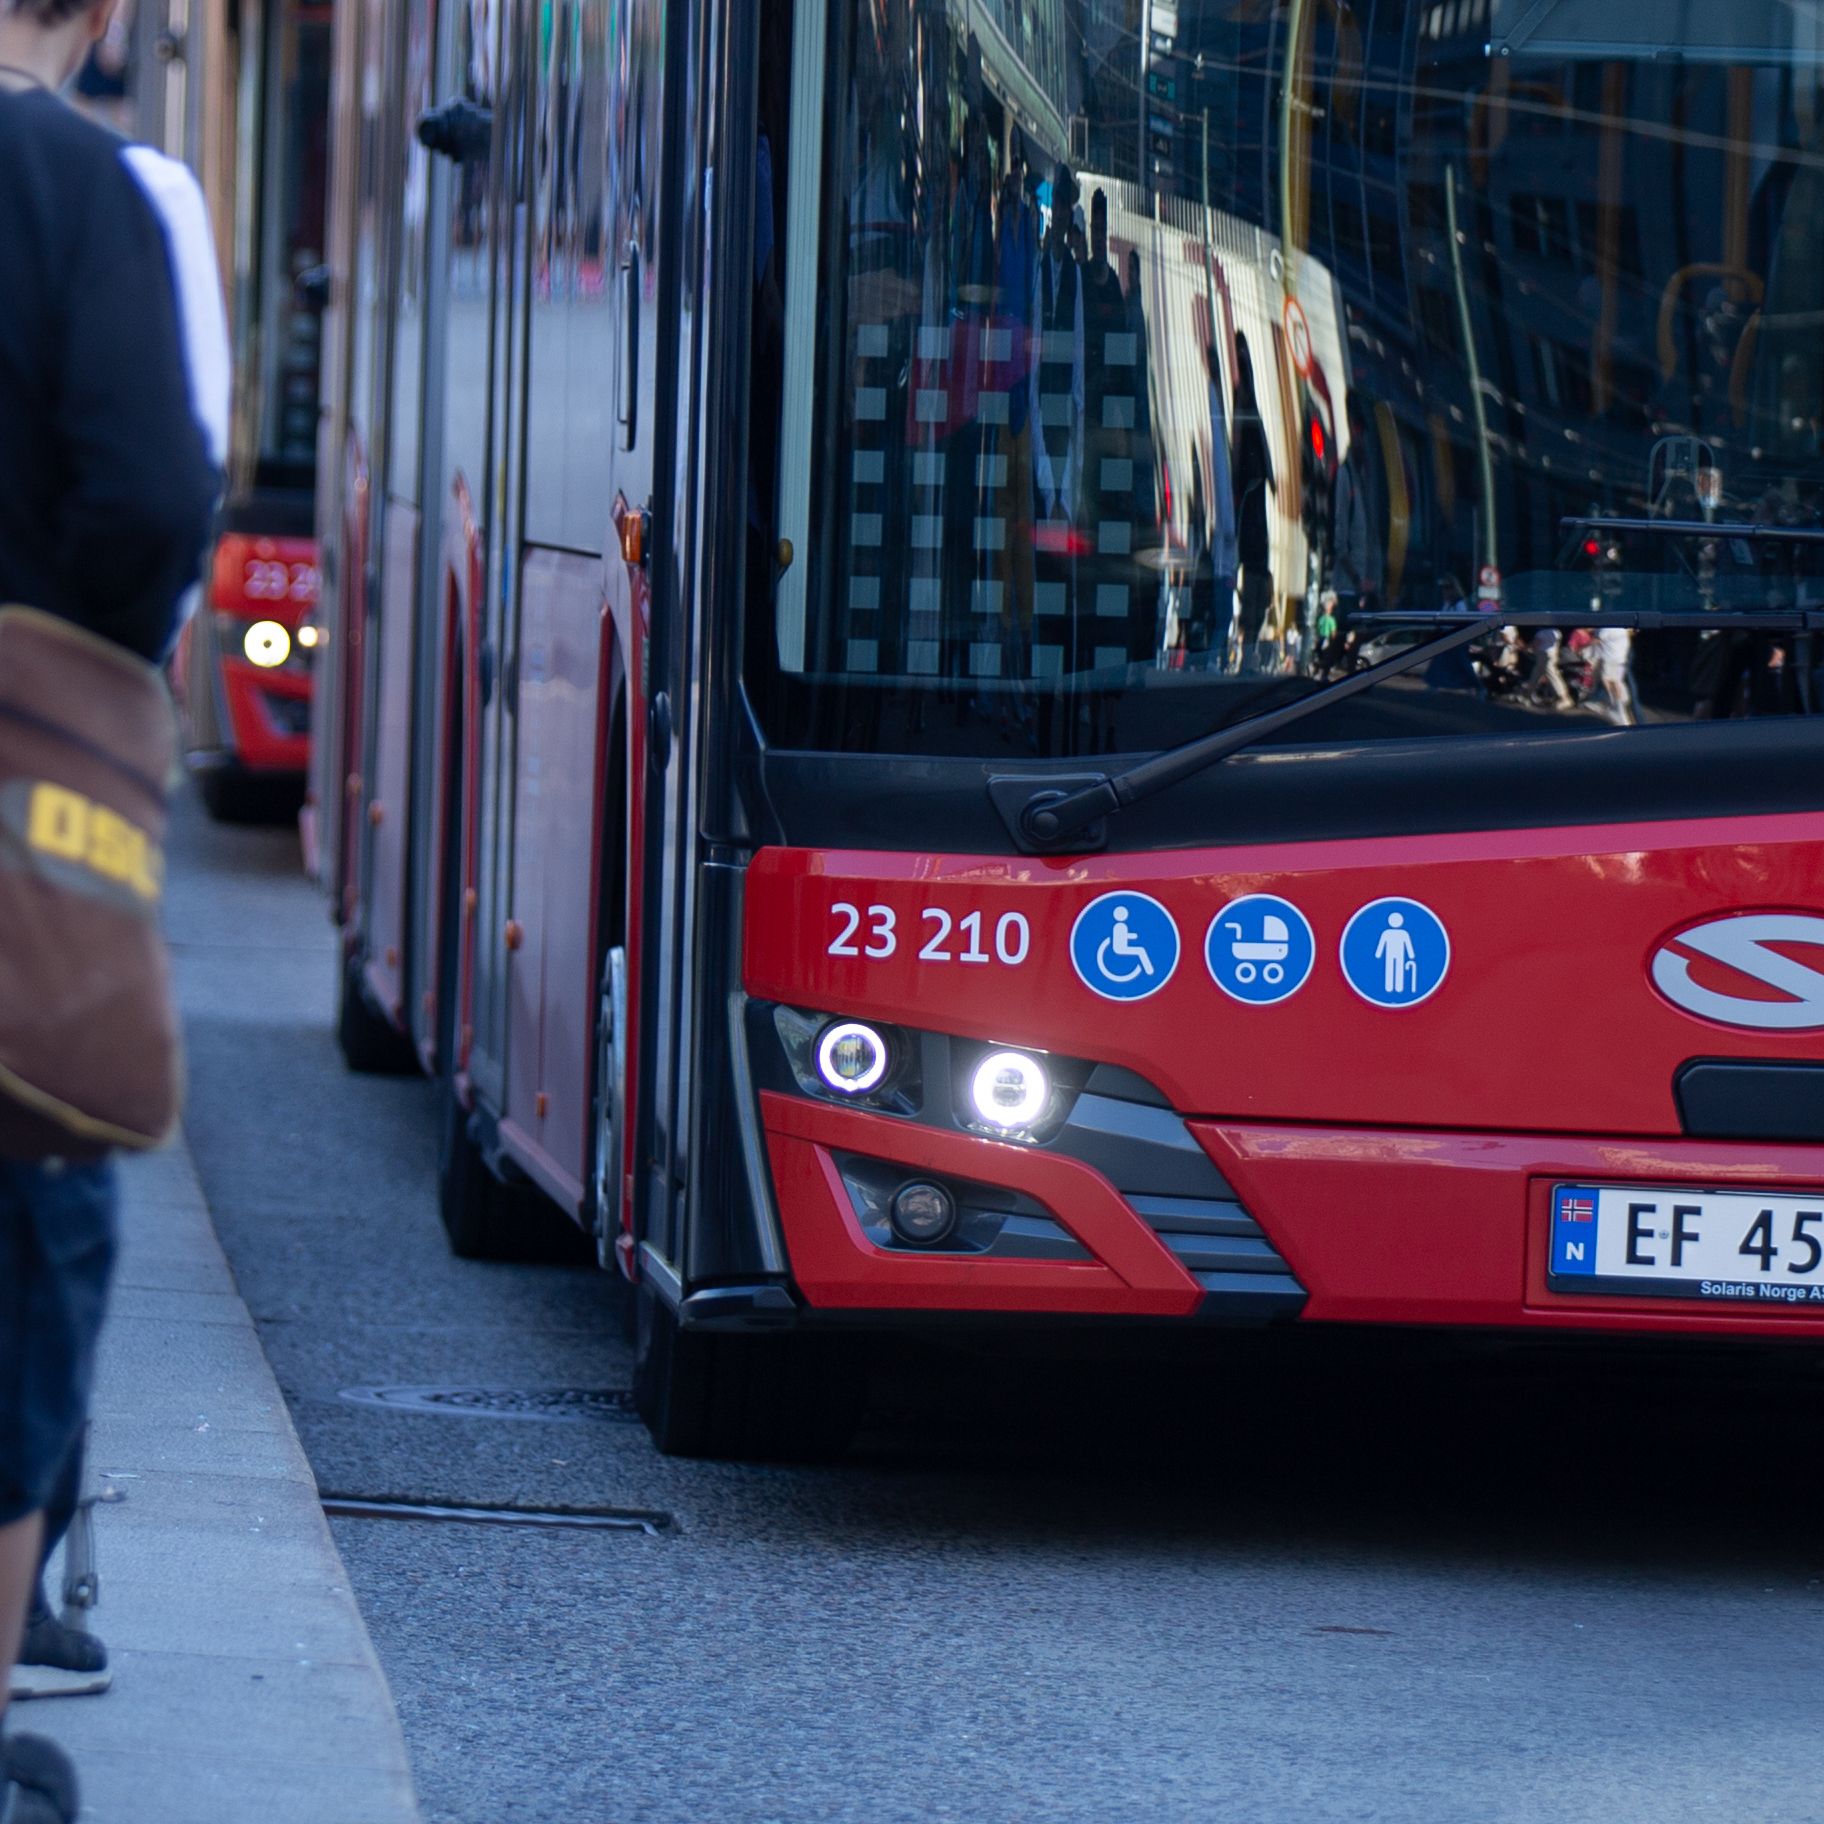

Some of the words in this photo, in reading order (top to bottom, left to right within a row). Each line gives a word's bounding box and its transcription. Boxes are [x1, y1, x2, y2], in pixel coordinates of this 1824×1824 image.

[827, 902, 897, 958] 23
[919, 908, 1030, 965] 210
[1564, 1242, 1585, 1262] N
[1625, 1202, 1703, 1267] EF
[1700, 1281, 1755, 1298] Solaris
[1759, 1283, 1807, 1301] Norge
